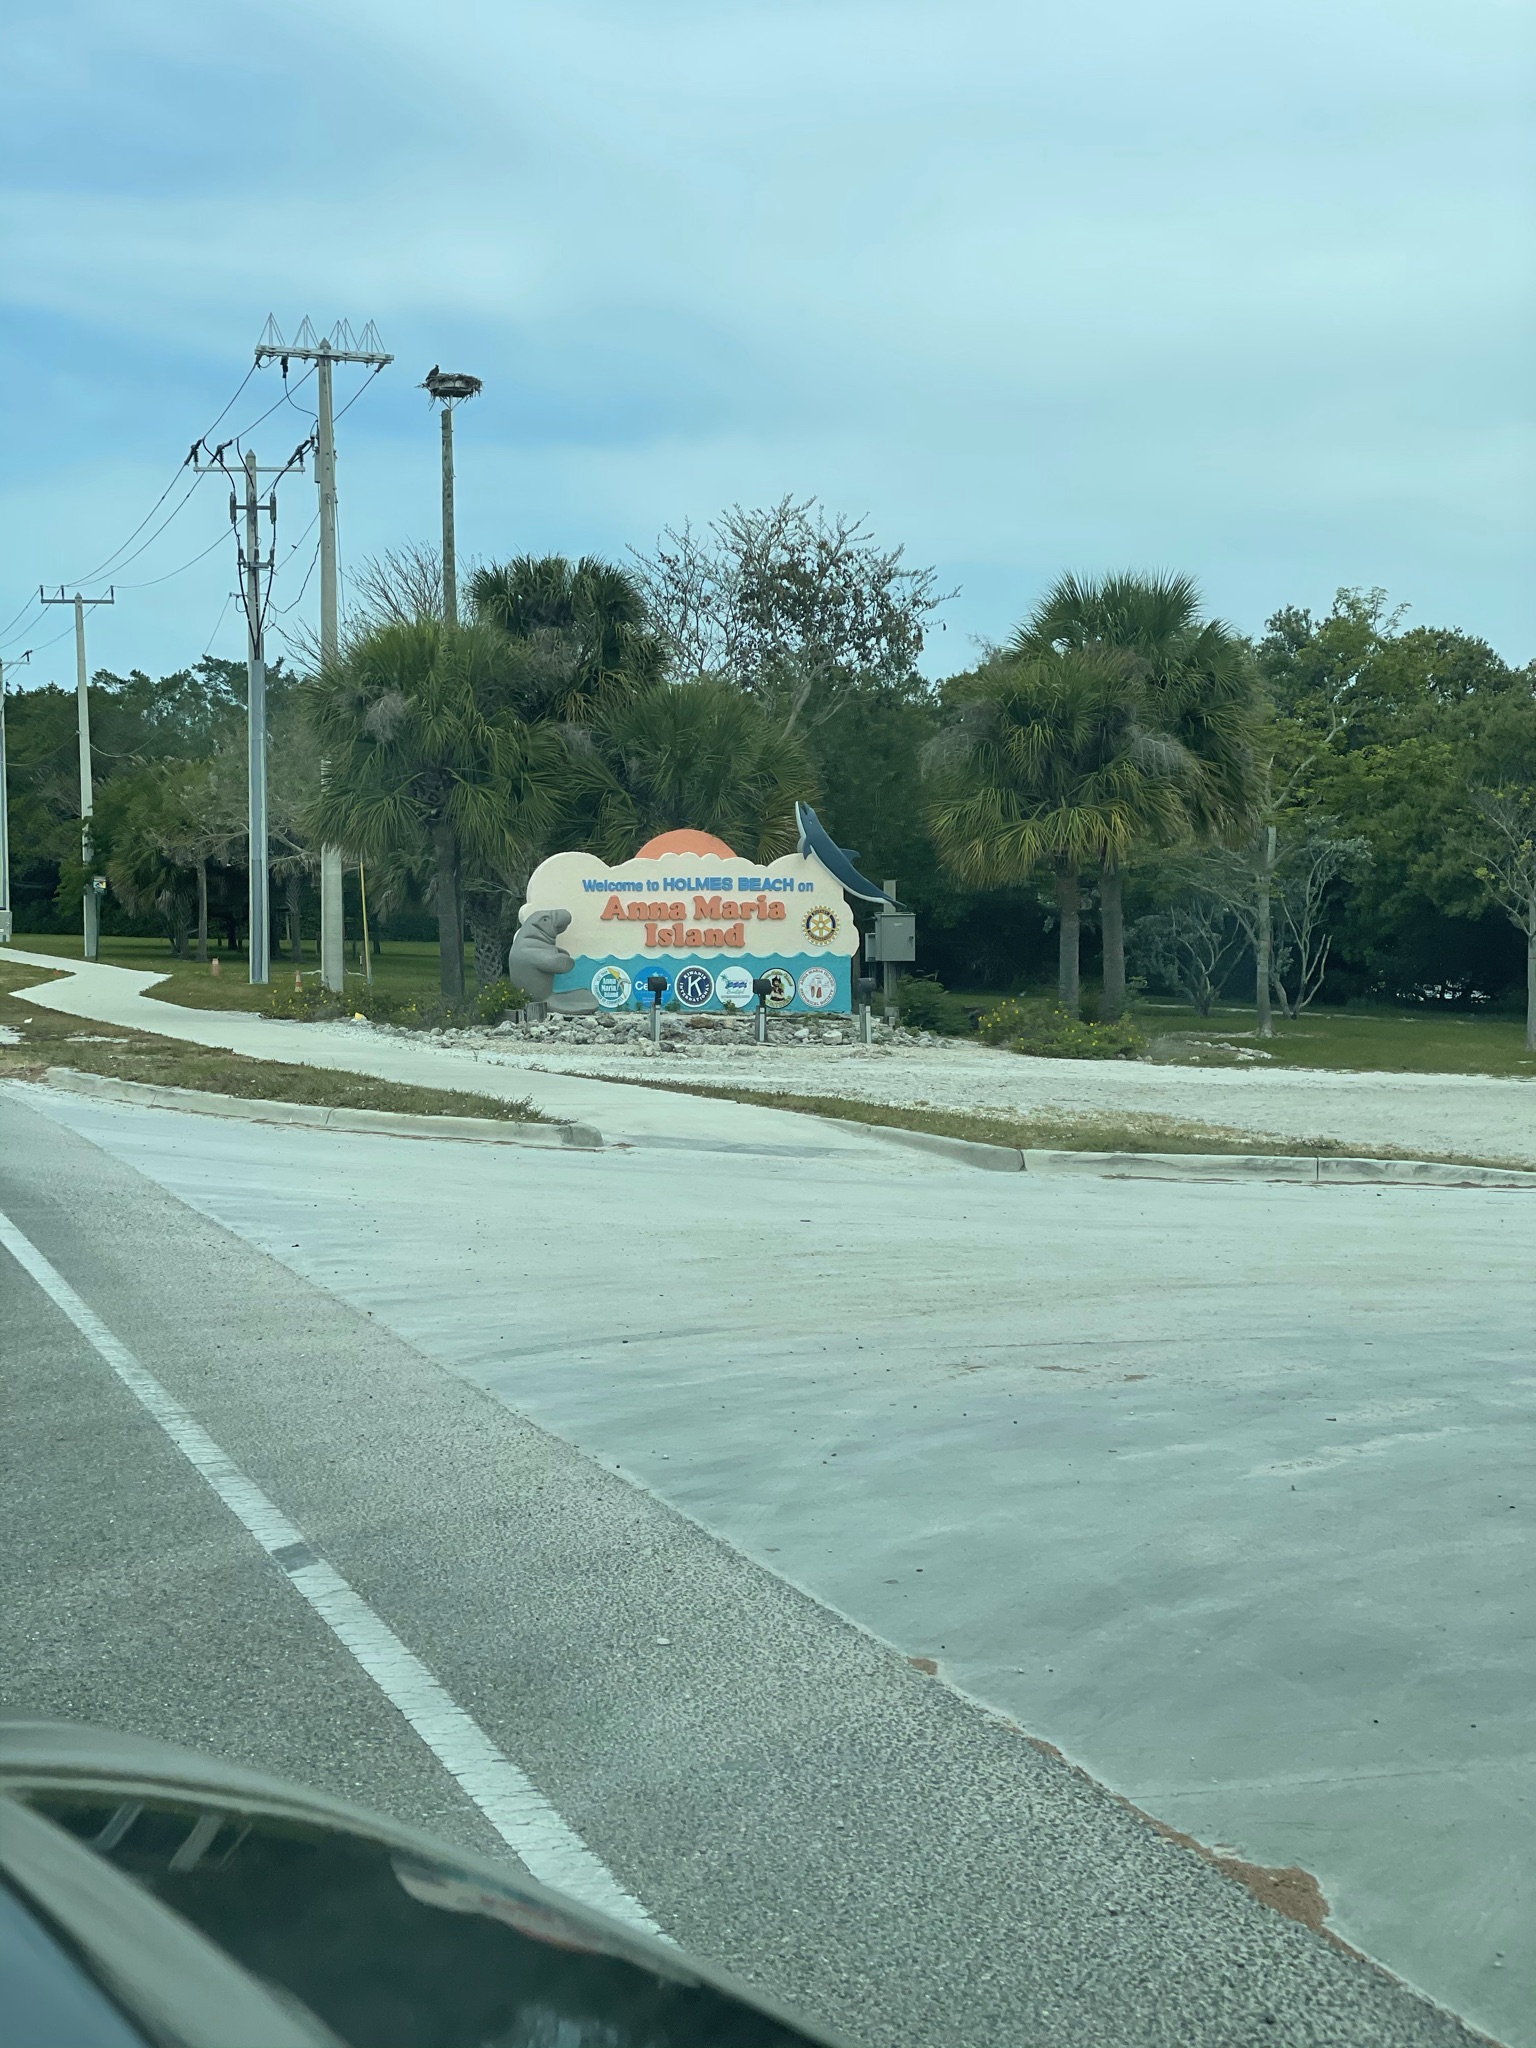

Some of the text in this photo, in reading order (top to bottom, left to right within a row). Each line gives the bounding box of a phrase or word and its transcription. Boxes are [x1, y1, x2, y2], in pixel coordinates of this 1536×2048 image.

[582, 876, 814, 892] Welcome to HOLMES BEACH on
[600, 894, 786, 921] Anna Maria
[644, 922, 746, 948] Island
[602, 977, 617, 985] Anna
[683, 971, 707, 980] KIWANIS
[601, 984, 617, 992] Maria
[634, 980, 671, 991] Cer
[679, 982, 710, 1002] INTERNATIONAL
[687, 976, 703, 997] K
